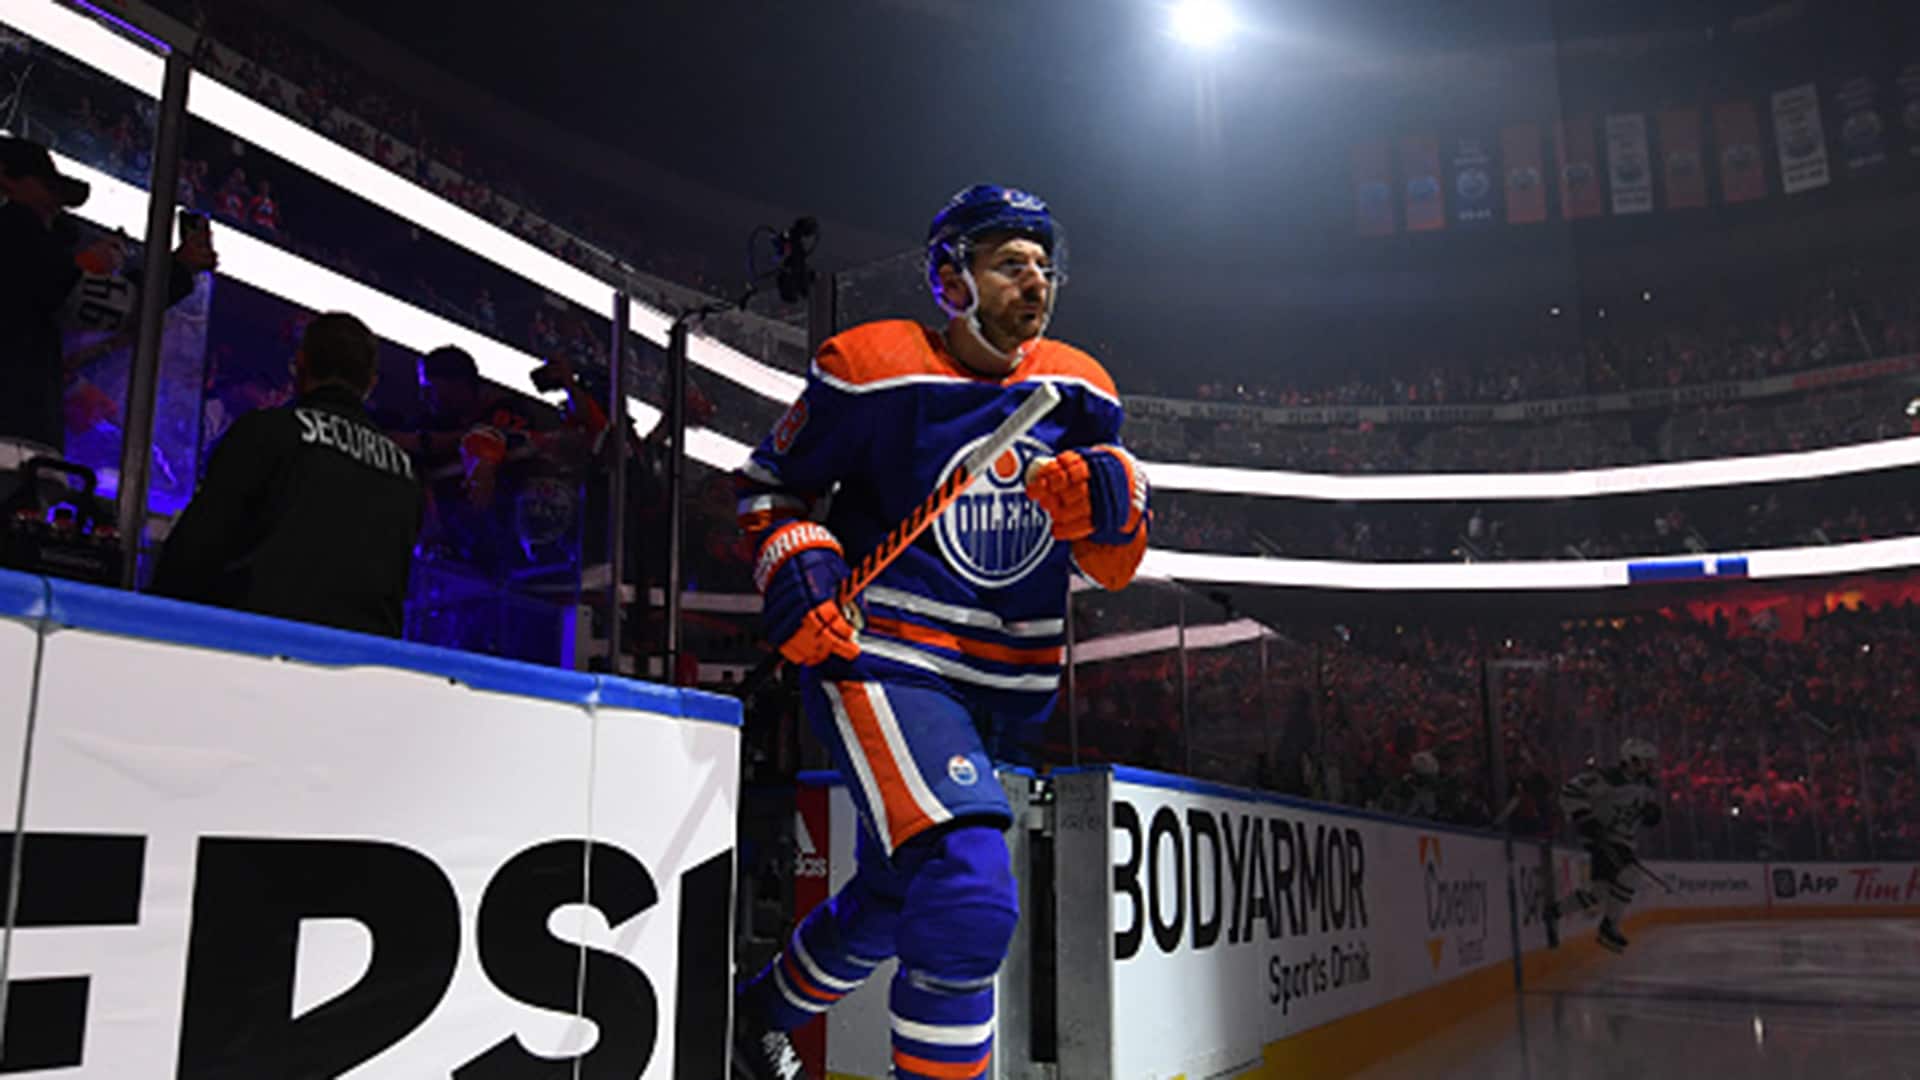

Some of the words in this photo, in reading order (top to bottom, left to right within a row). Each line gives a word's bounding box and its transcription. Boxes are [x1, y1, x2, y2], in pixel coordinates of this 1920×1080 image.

[294, 407, 415, 480] SECURITY
[1113, 801, 1367, 960] BODYARMOR
[1268, 954, 1328, 1017] Sports
[1331, 941, 1371, 988] Drink
